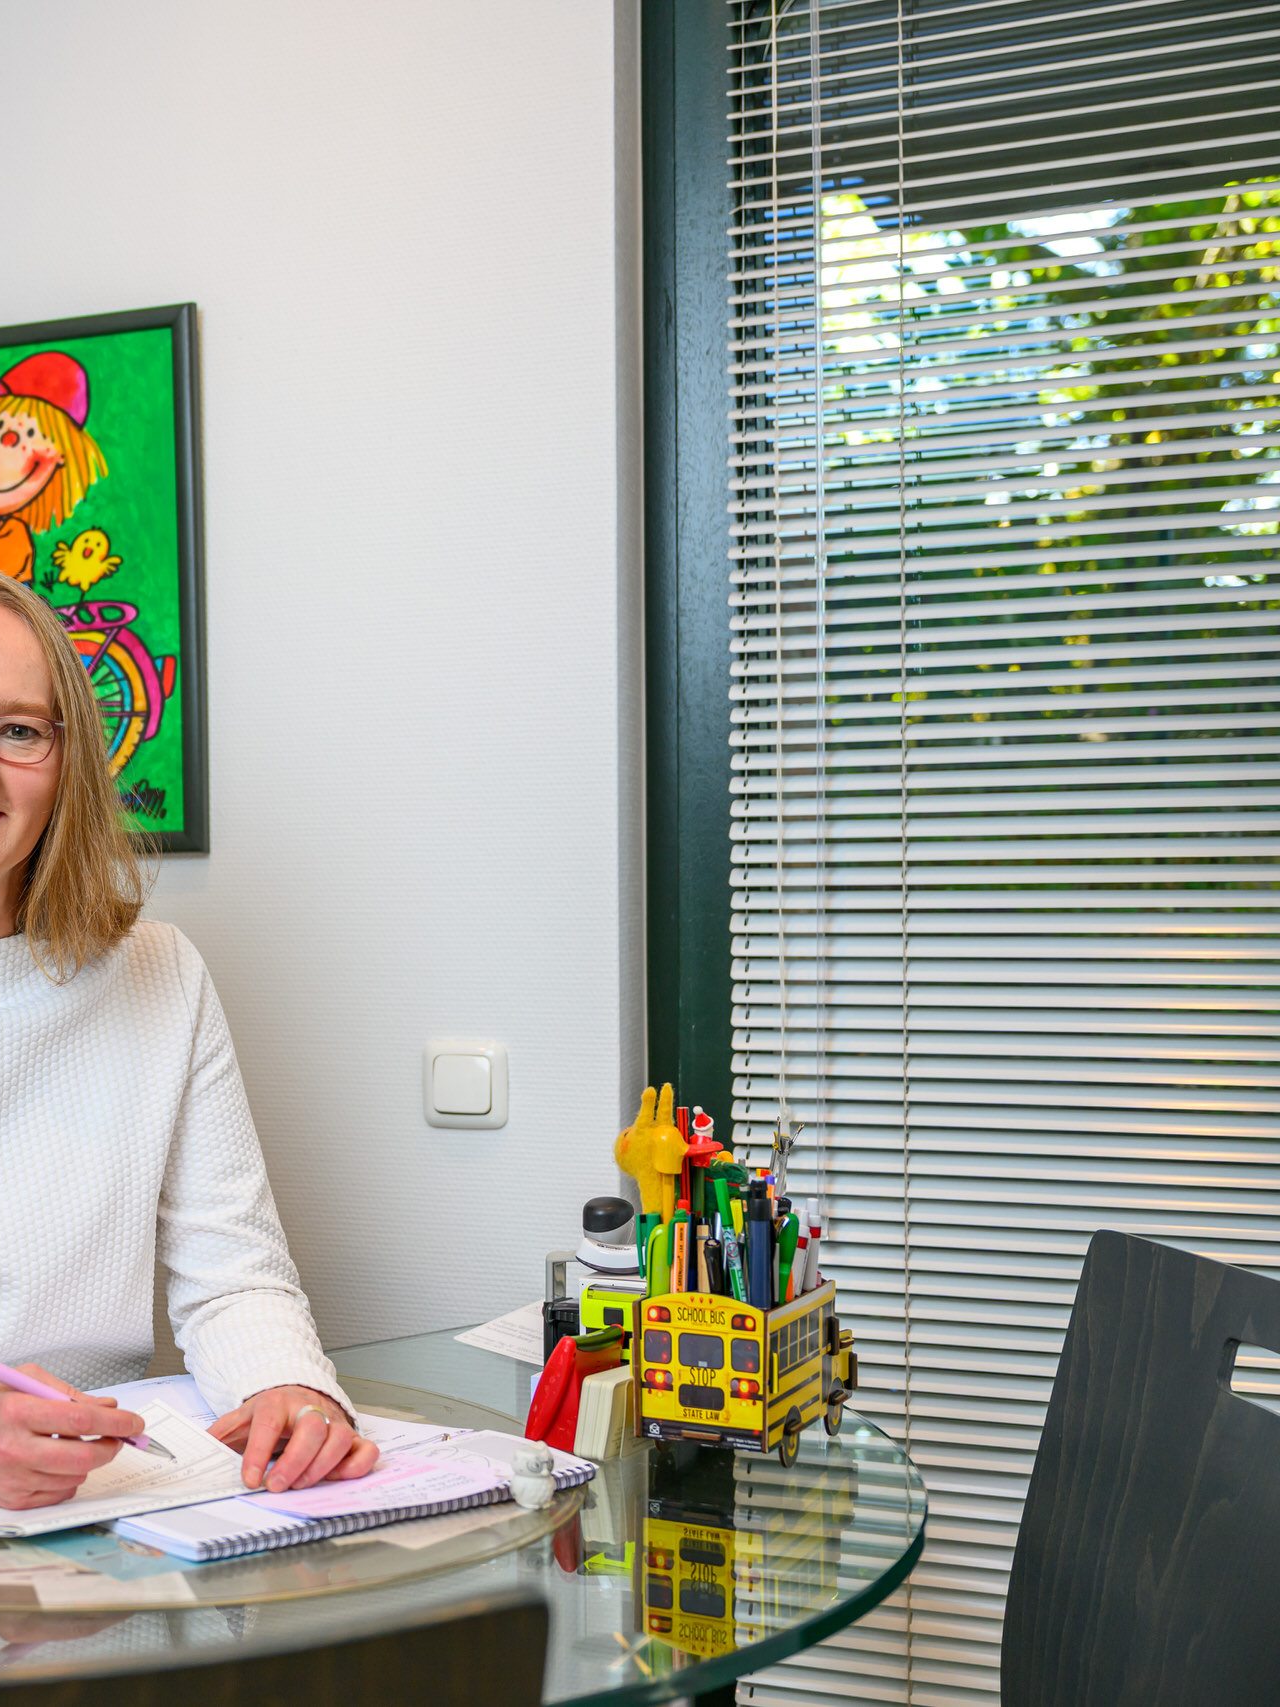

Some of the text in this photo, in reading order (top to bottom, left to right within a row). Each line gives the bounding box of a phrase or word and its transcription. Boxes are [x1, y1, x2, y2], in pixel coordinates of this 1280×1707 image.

[678, 1307, 726, 1326] SCHOOL BUS
[690, 1367, 716, 1386] STOP
[683, 1408, 720, 1421] STATE LAW
